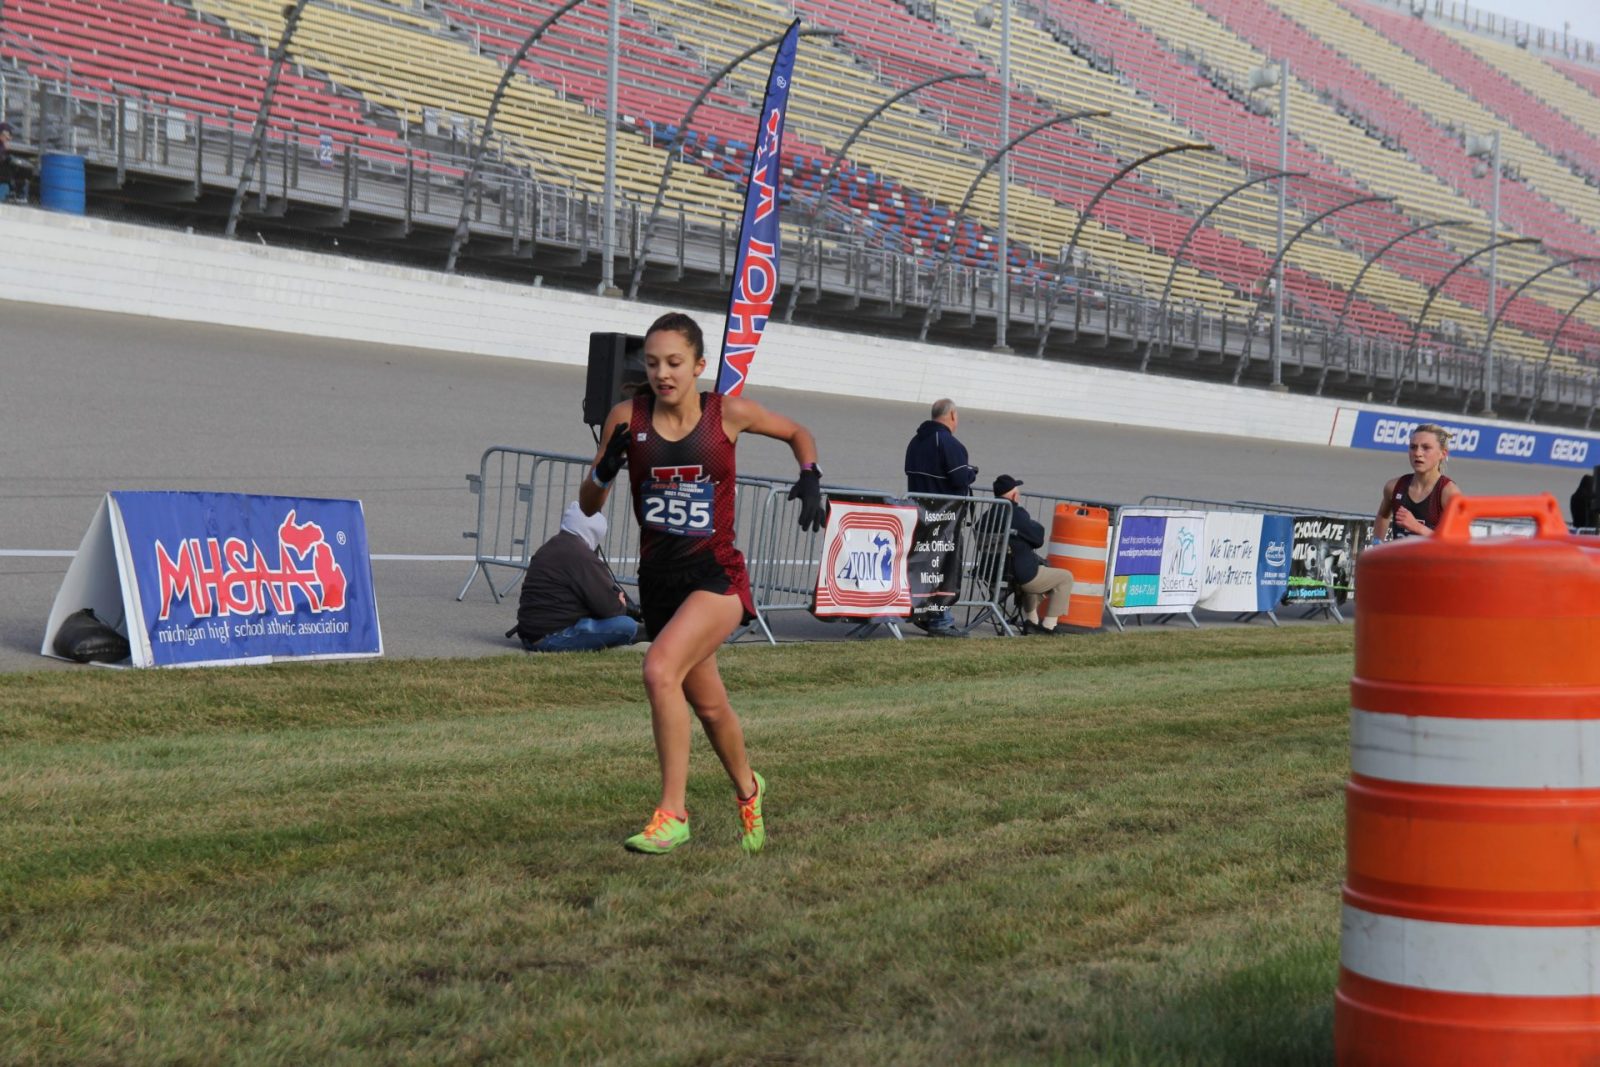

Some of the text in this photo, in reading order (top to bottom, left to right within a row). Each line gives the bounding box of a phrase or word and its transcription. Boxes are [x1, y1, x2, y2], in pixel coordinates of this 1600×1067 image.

[1496, 432, 1535, 457] GEICO
[1551, 438, 1589, 462] GEICO
[645, 497, 710, 528] 255
[932, 525, 941, 536] of
[1294, 521, 1345, 541] CHOCOLATE
[837, 551, 878, 580] ATOM
[931, 556, 940, 568] of
[155, 537, 322, 620] MHSAA
[920, 572, 944, 584] Michi
[158, 623, 206, 646] michigan
[234, 618, 265, 638] school
[267, 618, 296, 636] athtic
[298, 617, 349, 635] association
